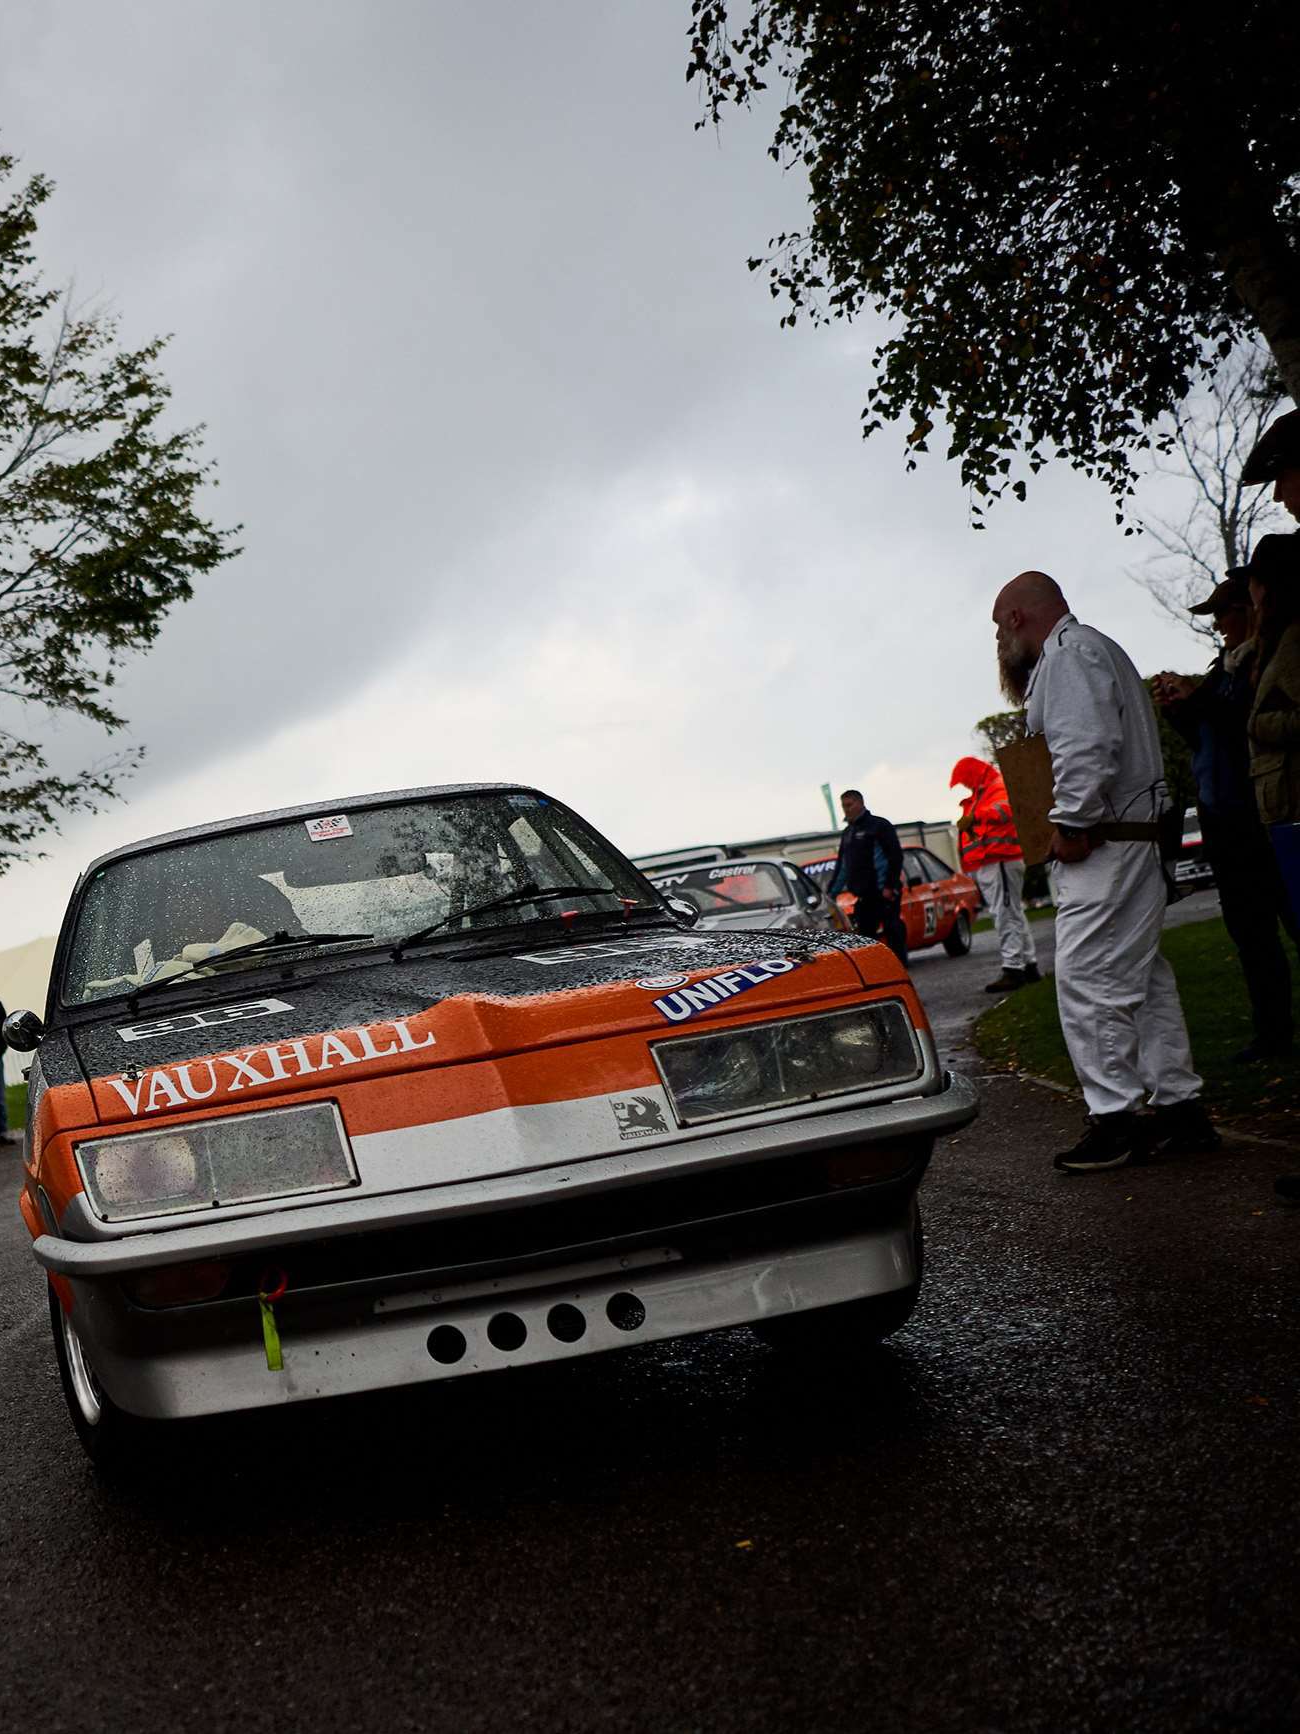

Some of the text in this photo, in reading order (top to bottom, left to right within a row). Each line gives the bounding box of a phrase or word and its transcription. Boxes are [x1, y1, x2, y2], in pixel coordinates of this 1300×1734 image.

[708, 864, 756, 879] Castrol
[654, 959, 794, 1021] UNIFLO
[106, 1020, 436, 1115] VAUXHALL
[620, 1128, 667, 1139] VAUXHALL
